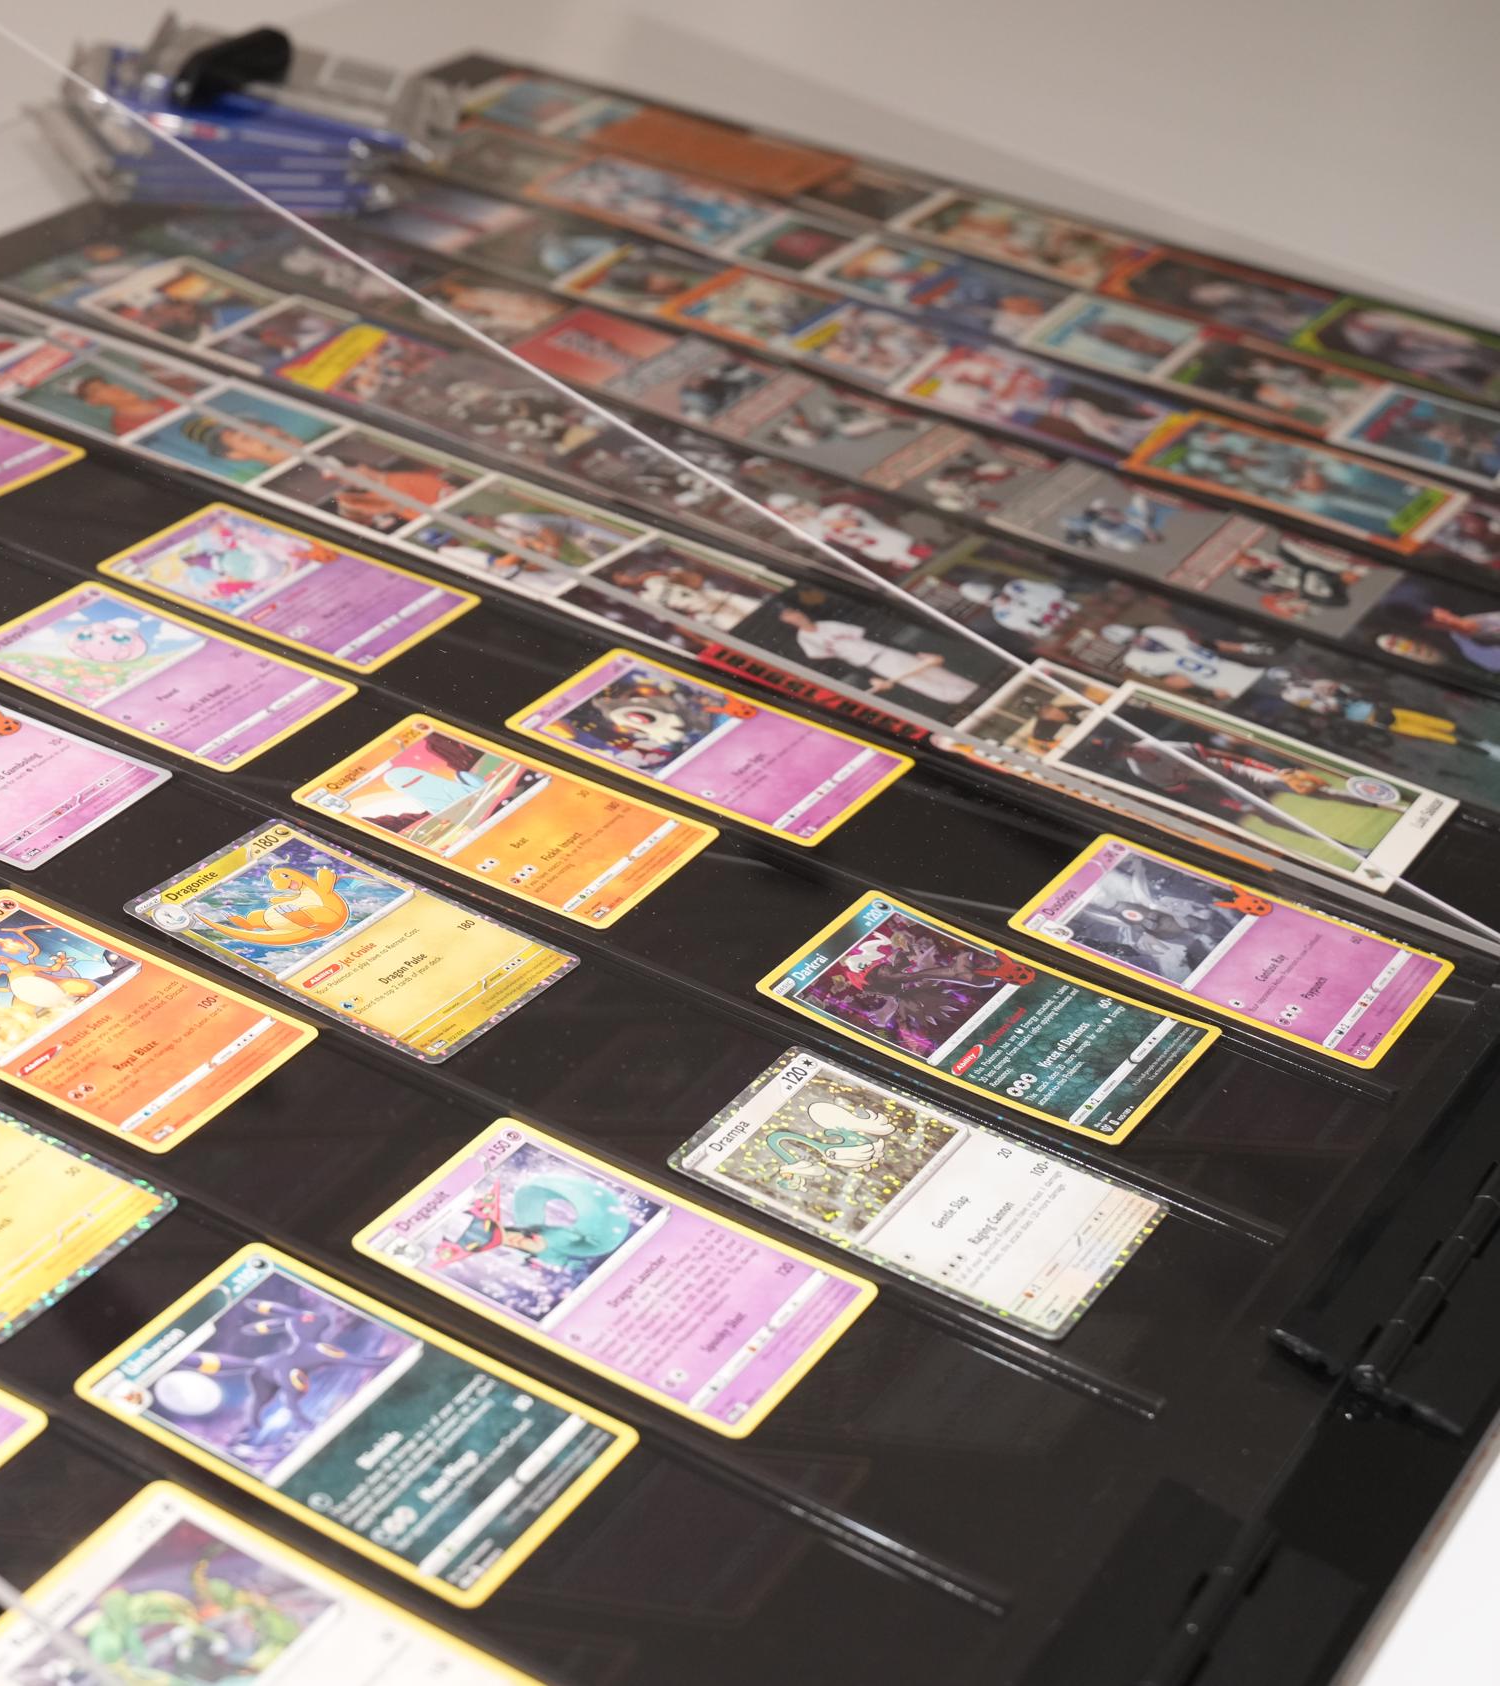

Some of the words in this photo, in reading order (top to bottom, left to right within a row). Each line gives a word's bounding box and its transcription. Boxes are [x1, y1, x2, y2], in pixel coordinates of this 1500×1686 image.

[2, 753, 42, 775] Gamboling
[326, 766, 366, 789] Quagsire
[252, 834, 280, 850] 180
[539, 846, 562, 861] Fickle
[558, 832, 584, 848] Impact
[165, 872, 217, 900] Dragonite
[1041, 888, 1078, 916] Dusclops
[456, 920, 476, 930] 180
[862, 908, 884, 922] 120
[338, 956, 356, 966] Jet
[350, 942, 376, 958] Cruise
[309, 968, 334, 984] Ability
[378, 965, 410, 984] Dragon
[404, 953, 428, 967] Pulse
[792, 954, 828, 980] Darkrai
[1254, 962, 1279, 982] Confuse
[1270, 953, 1288, 964] Ray
[1300, 976, 1329, 1000] Psypunch
[1060, 1021, 1090, 1046] Darkness
[112, 1054, 138, 1070] Royal
[134, 1040, 159, 1056] Blaze
[1036, 1050, 1062, 1068] Vortex
[1054, 1042, 1068, 1052] of
[22, 1054, 51, 1072] Ability
[954, 1052, 977, 1070] Ability
[781, 1066, 808, 1084] 120
[487, 1140, 512, 1156] 150
[709, 1121, 749, 1151] Drampa
[996, 1148, 1012, 1158] 20
[395, 1191, 449, 1231] Dragapult
[930, 1208, 956, 1228] Gentle
[948, 1194, 972, 1210] Slap
[968, 1223, 996, 1245] Raging
[986, 1200, 1014, 1224] Cannon
